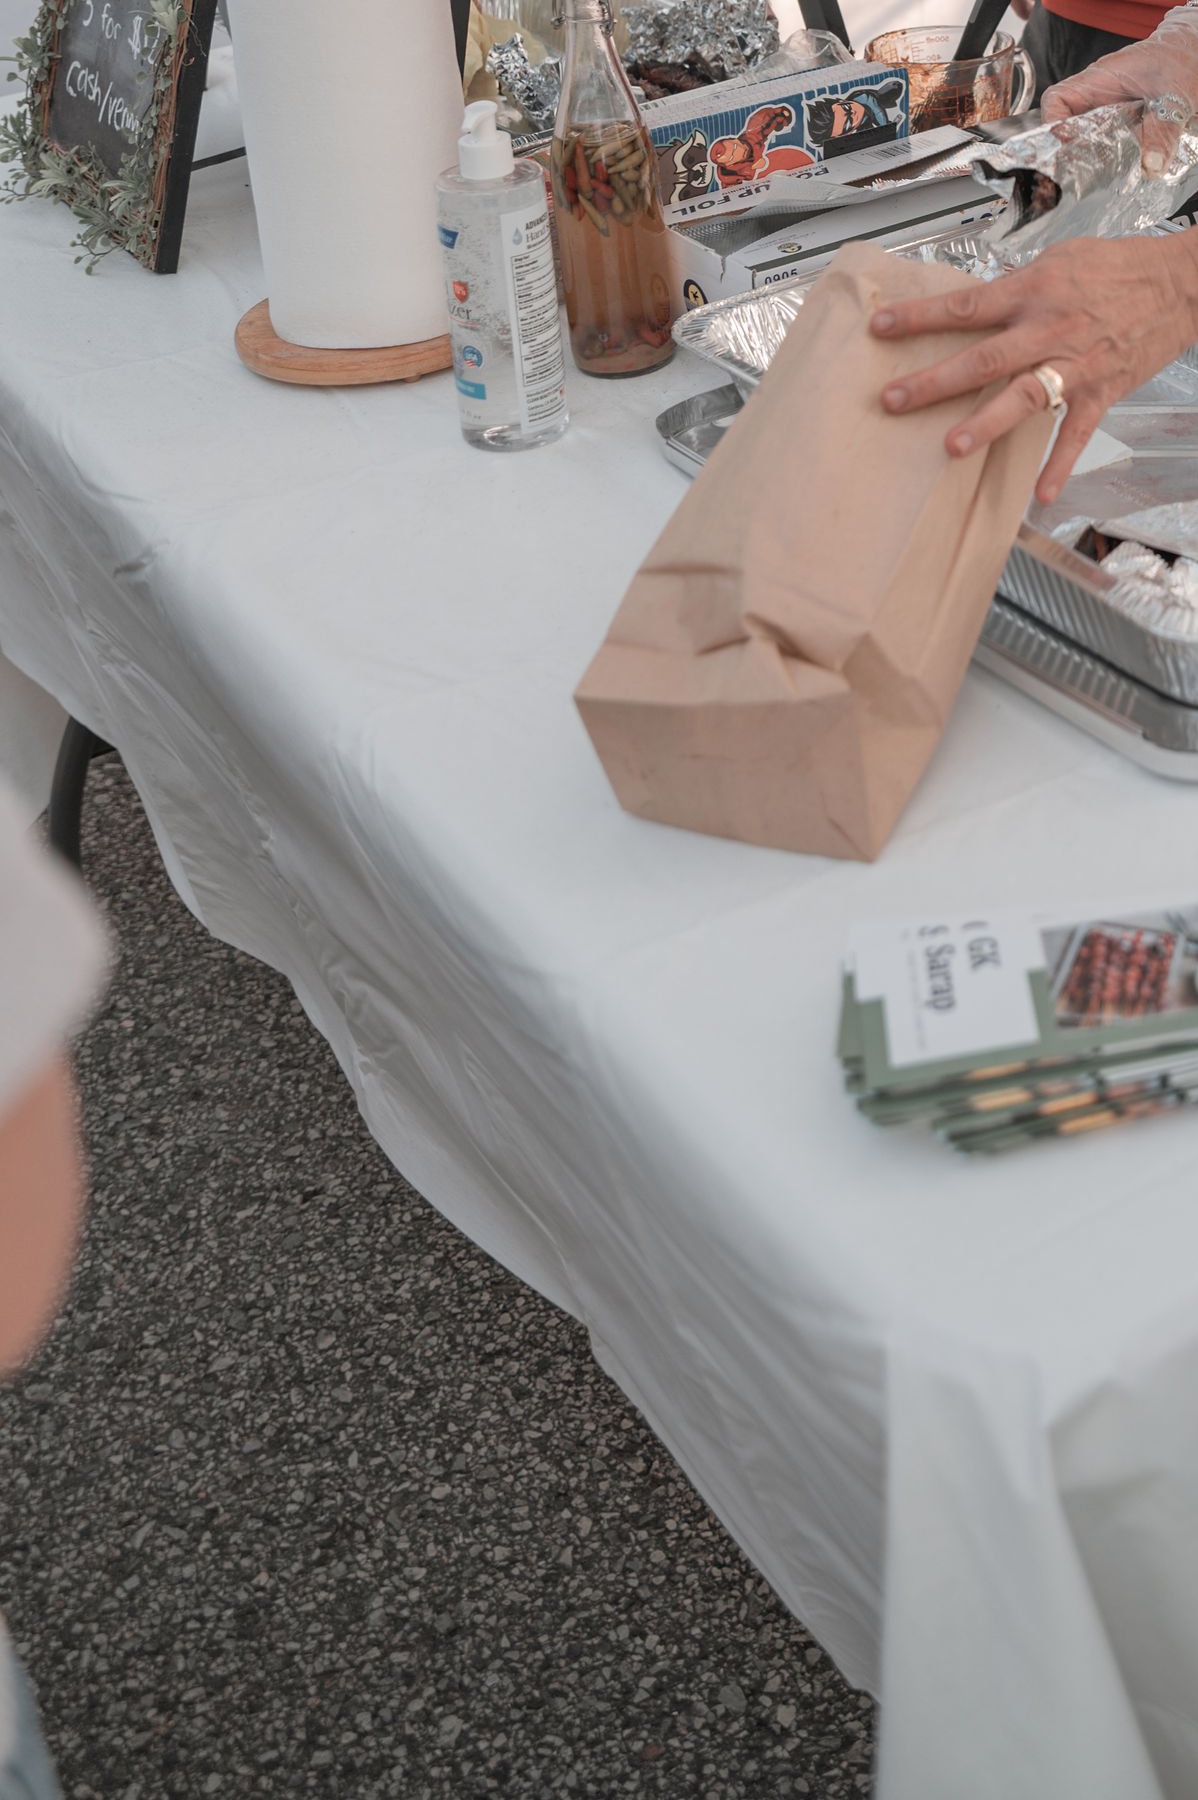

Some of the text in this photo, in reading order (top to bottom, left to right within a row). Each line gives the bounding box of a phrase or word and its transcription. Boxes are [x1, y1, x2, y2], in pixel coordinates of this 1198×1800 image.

[101, 2, 121, 40] for
[671, 166, 830, 217] PO UP FOIL
[966, 935, 1002, 973] GK
[924, 942, 956, 1013] Sarap
